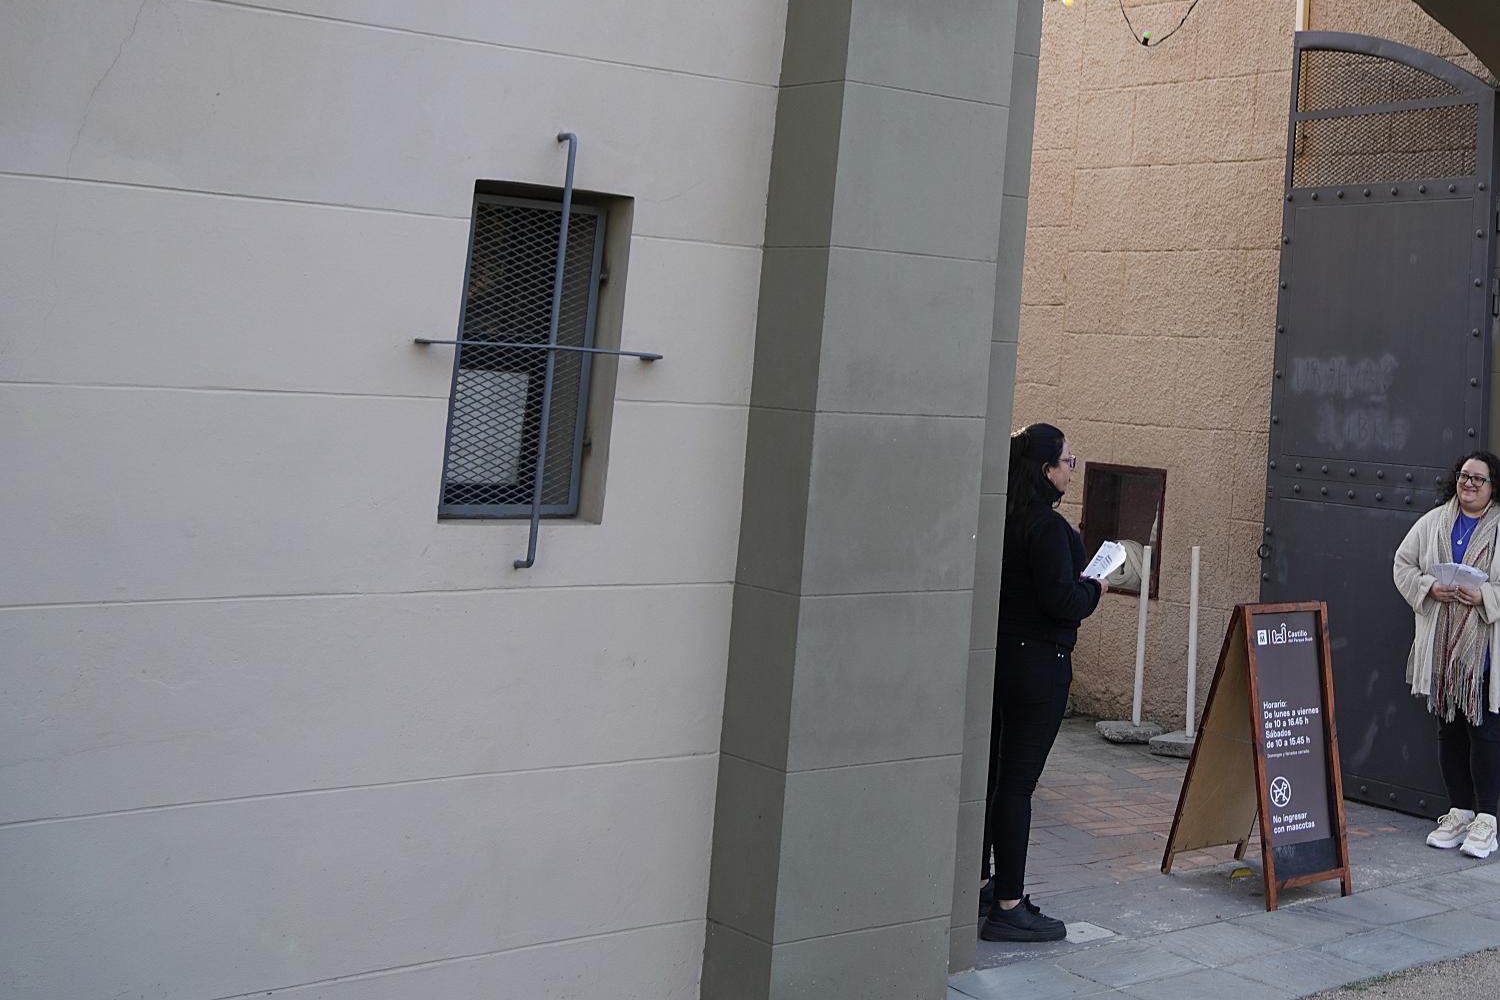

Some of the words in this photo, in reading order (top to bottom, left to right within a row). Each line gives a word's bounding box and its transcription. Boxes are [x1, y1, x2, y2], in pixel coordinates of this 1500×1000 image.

[1263, 699, 1287, 709] Horario:
[1264, 710, 1273, 719] De
[1274, 709, 1290, 718] lunes
[1297, 706, 1319, 716] viernes
[1273, 719, 1281, 728] 10
[1288, 717, 1303, 726] 16.45
[1304, 716, 1309, 725] h
[1266, 729, 1291, 738] Sábados
[1275, 738, 1283, 748] 10
[1289, 736, 1304, 745] 15.45
[1273, 815, 1281, 823] No
[1283, 813, 1307, 823] ingresar
[1287, 821, 1315, 831] mascotas
